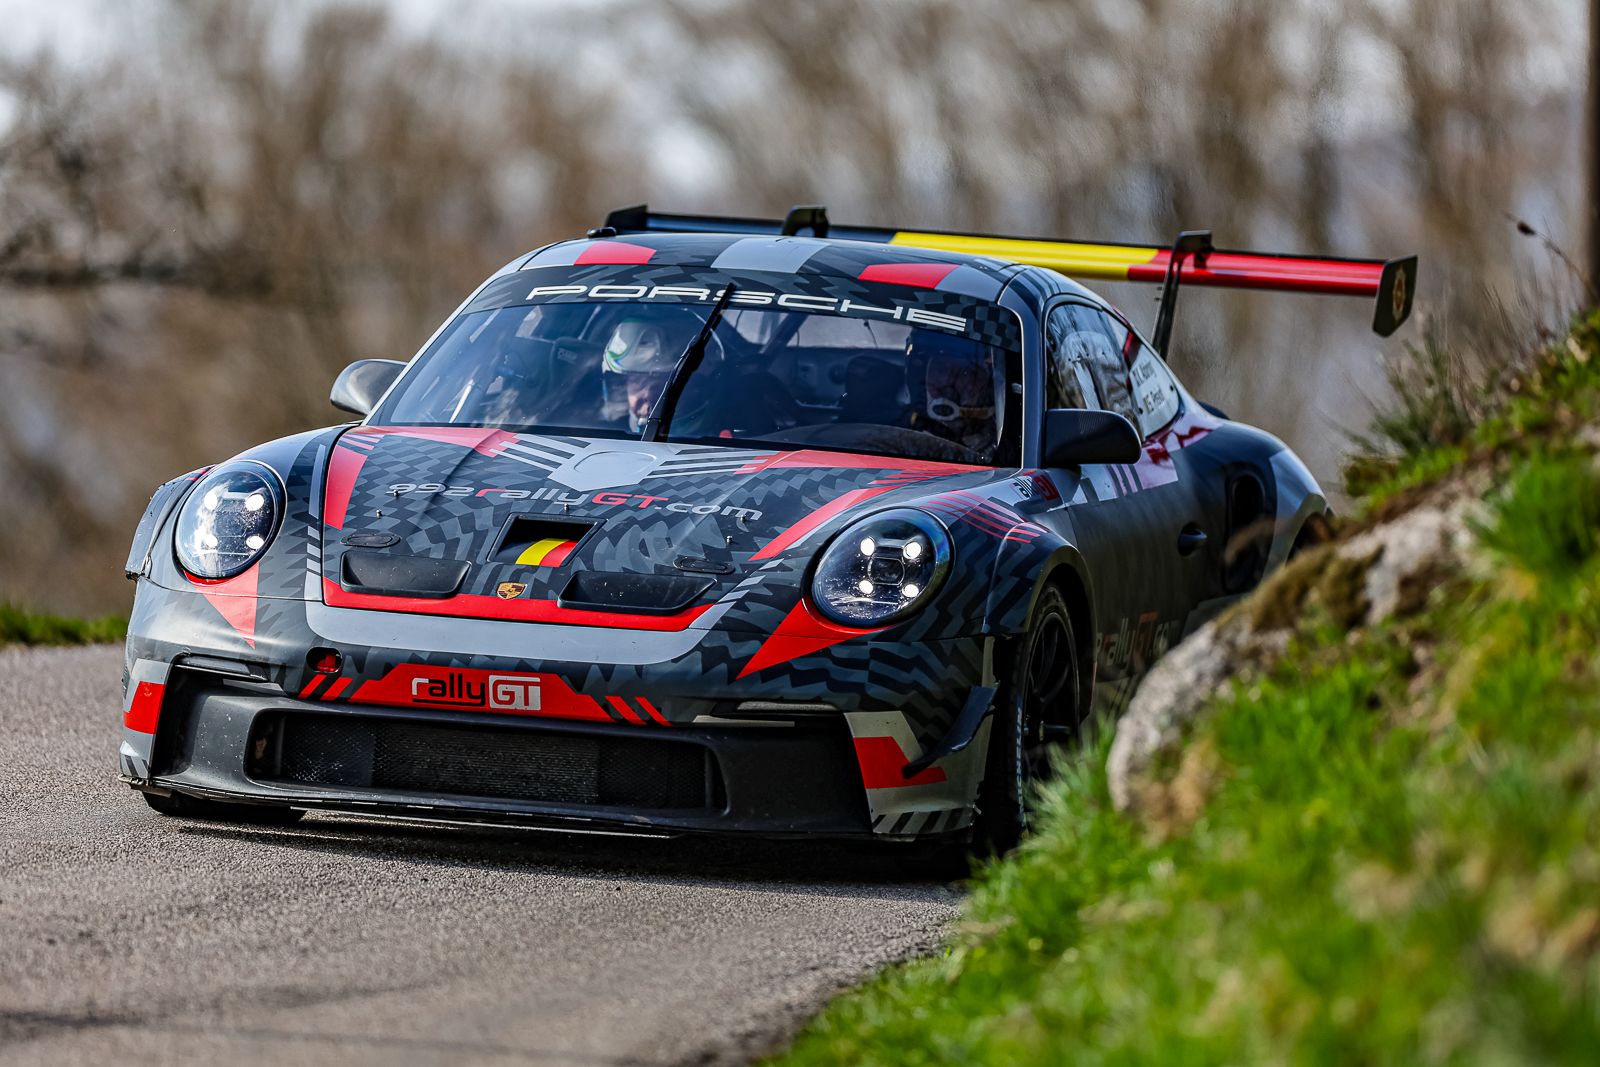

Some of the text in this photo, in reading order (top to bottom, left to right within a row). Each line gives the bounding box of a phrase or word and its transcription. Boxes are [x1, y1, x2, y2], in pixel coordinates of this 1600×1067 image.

[525, 284, 967, 332] PORSCHE
[386, 483, 763, 521] 992rallyGT.com
[411, 672, 541, 711] rallyGT
